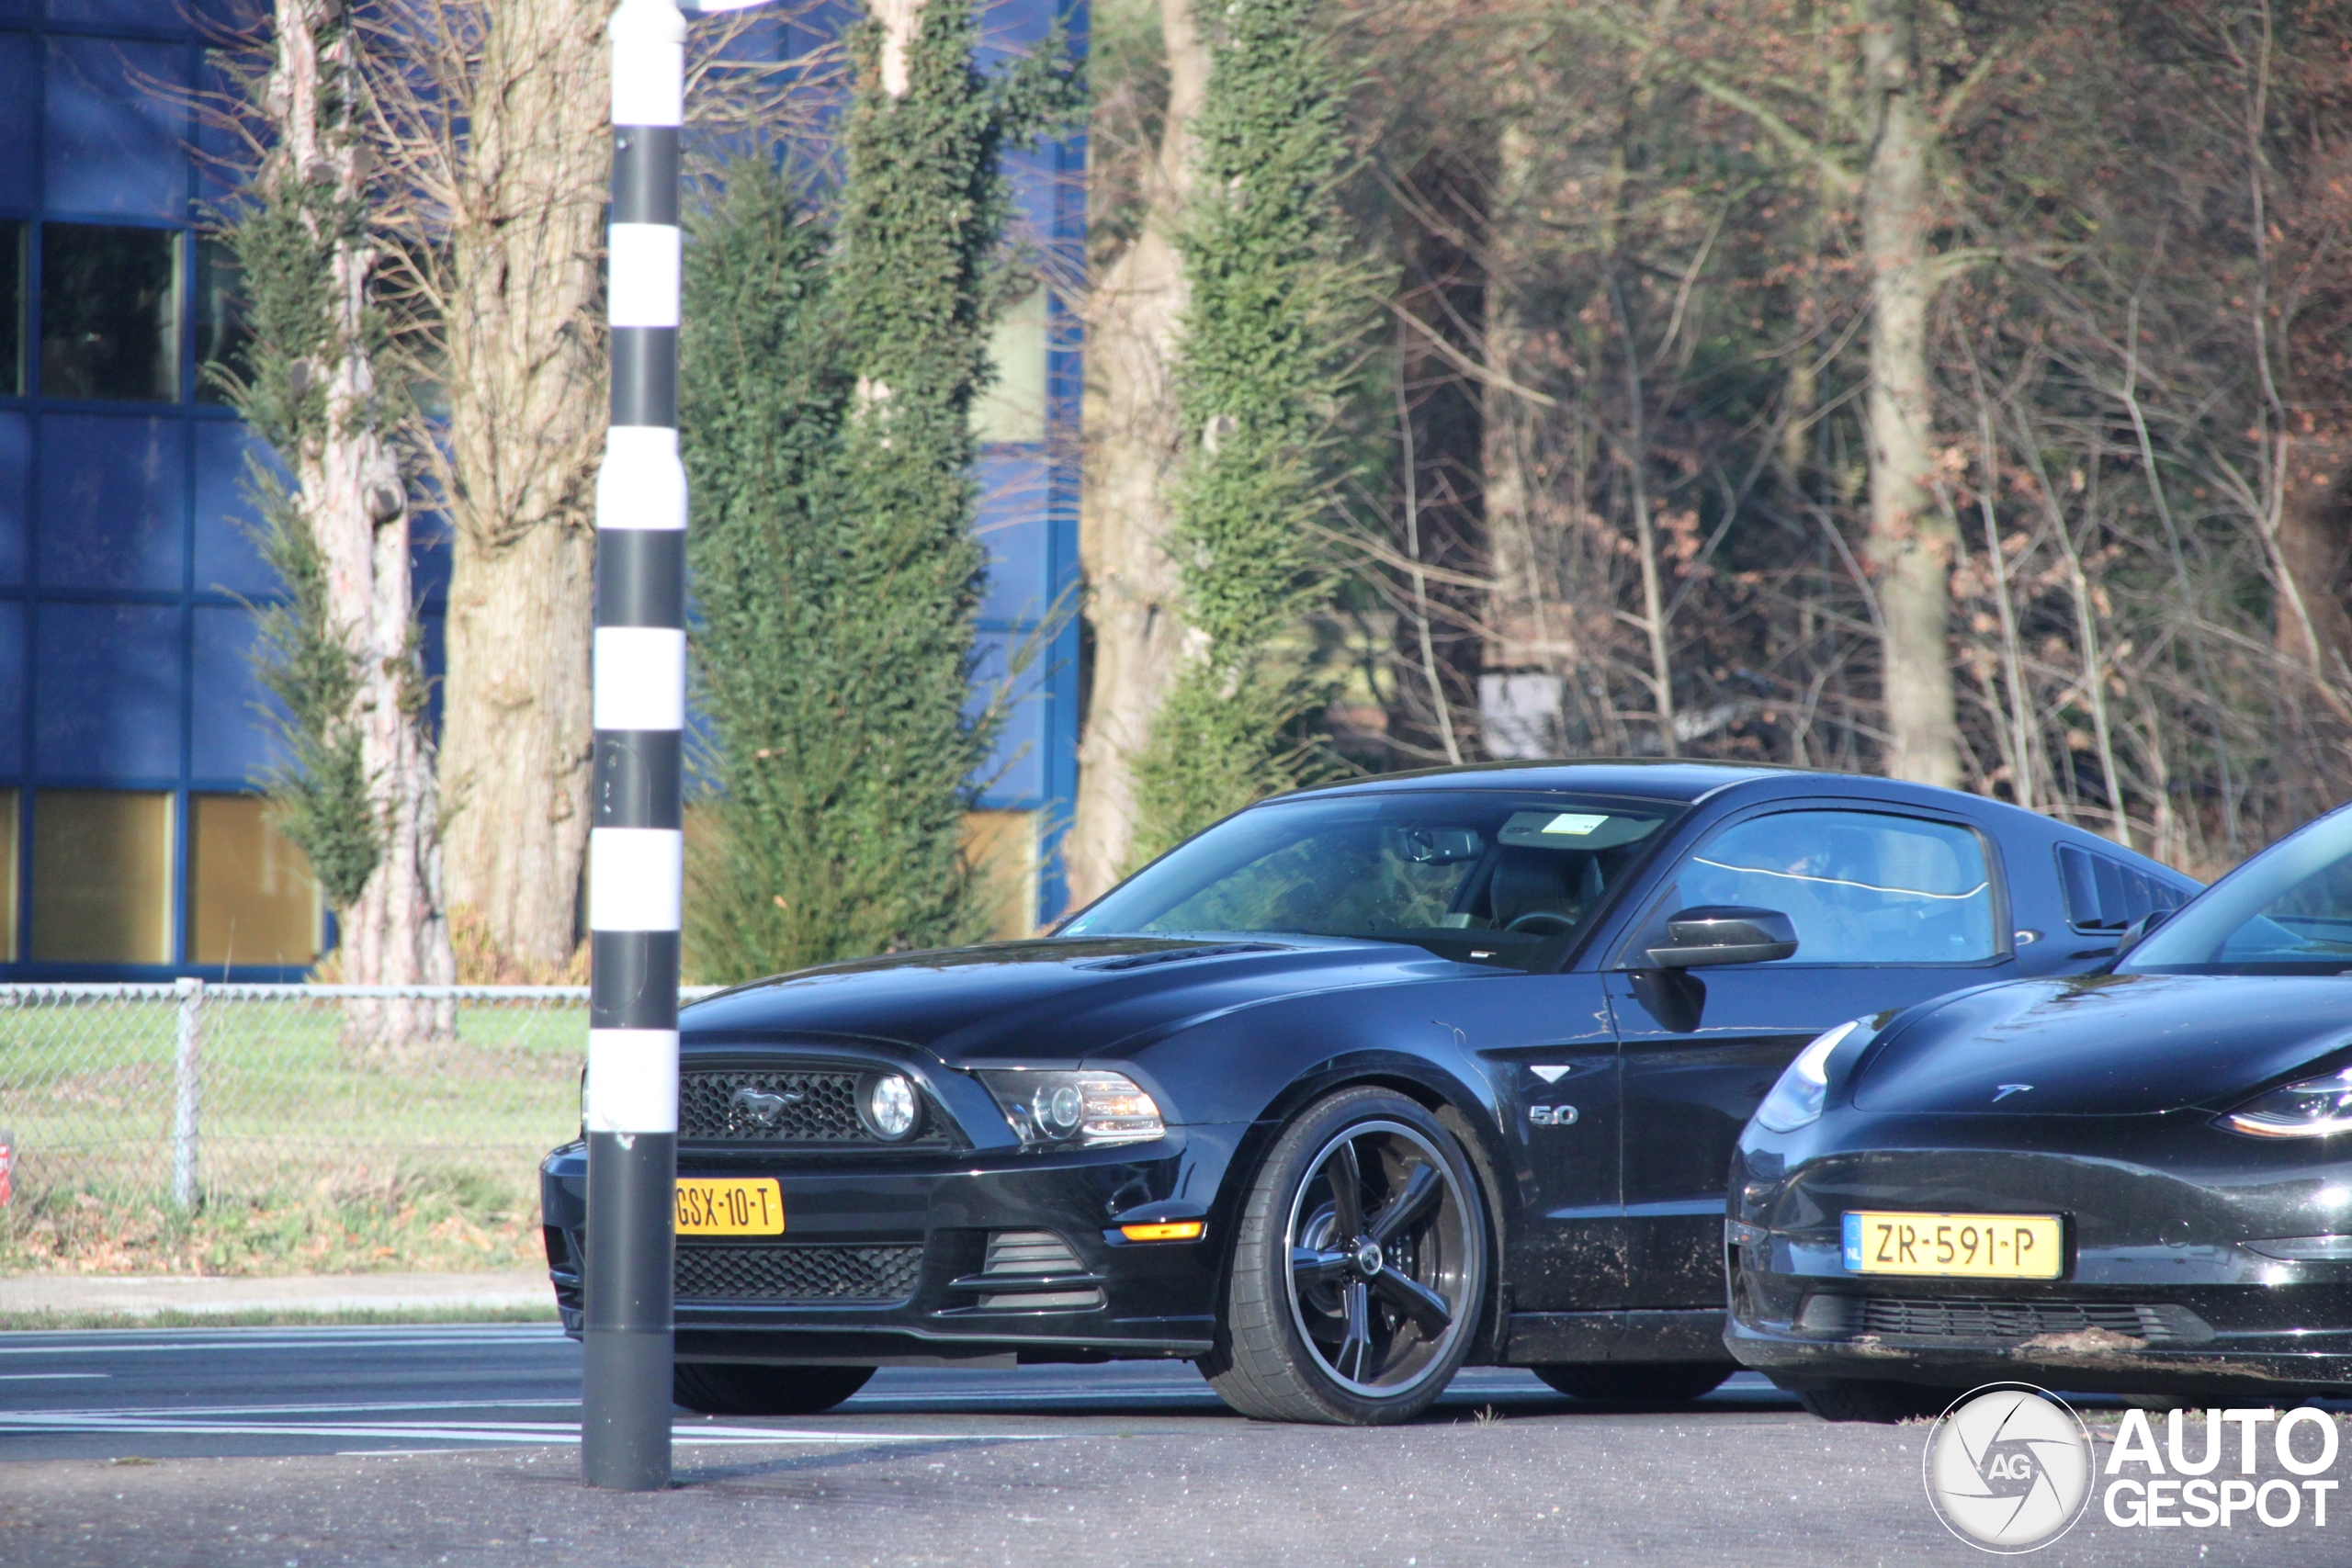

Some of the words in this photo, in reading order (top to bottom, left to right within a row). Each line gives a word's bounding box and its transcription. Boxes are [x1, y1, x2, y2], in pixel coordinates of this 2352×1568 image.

[1530, 1105, 1579, 1125] 5.0
[676, 1188, 768, 1226] GSX-10-T
[1847, 1247, 1861, 1259] NL
[1876, 1224, 2034, 1266] ZR-591-P
